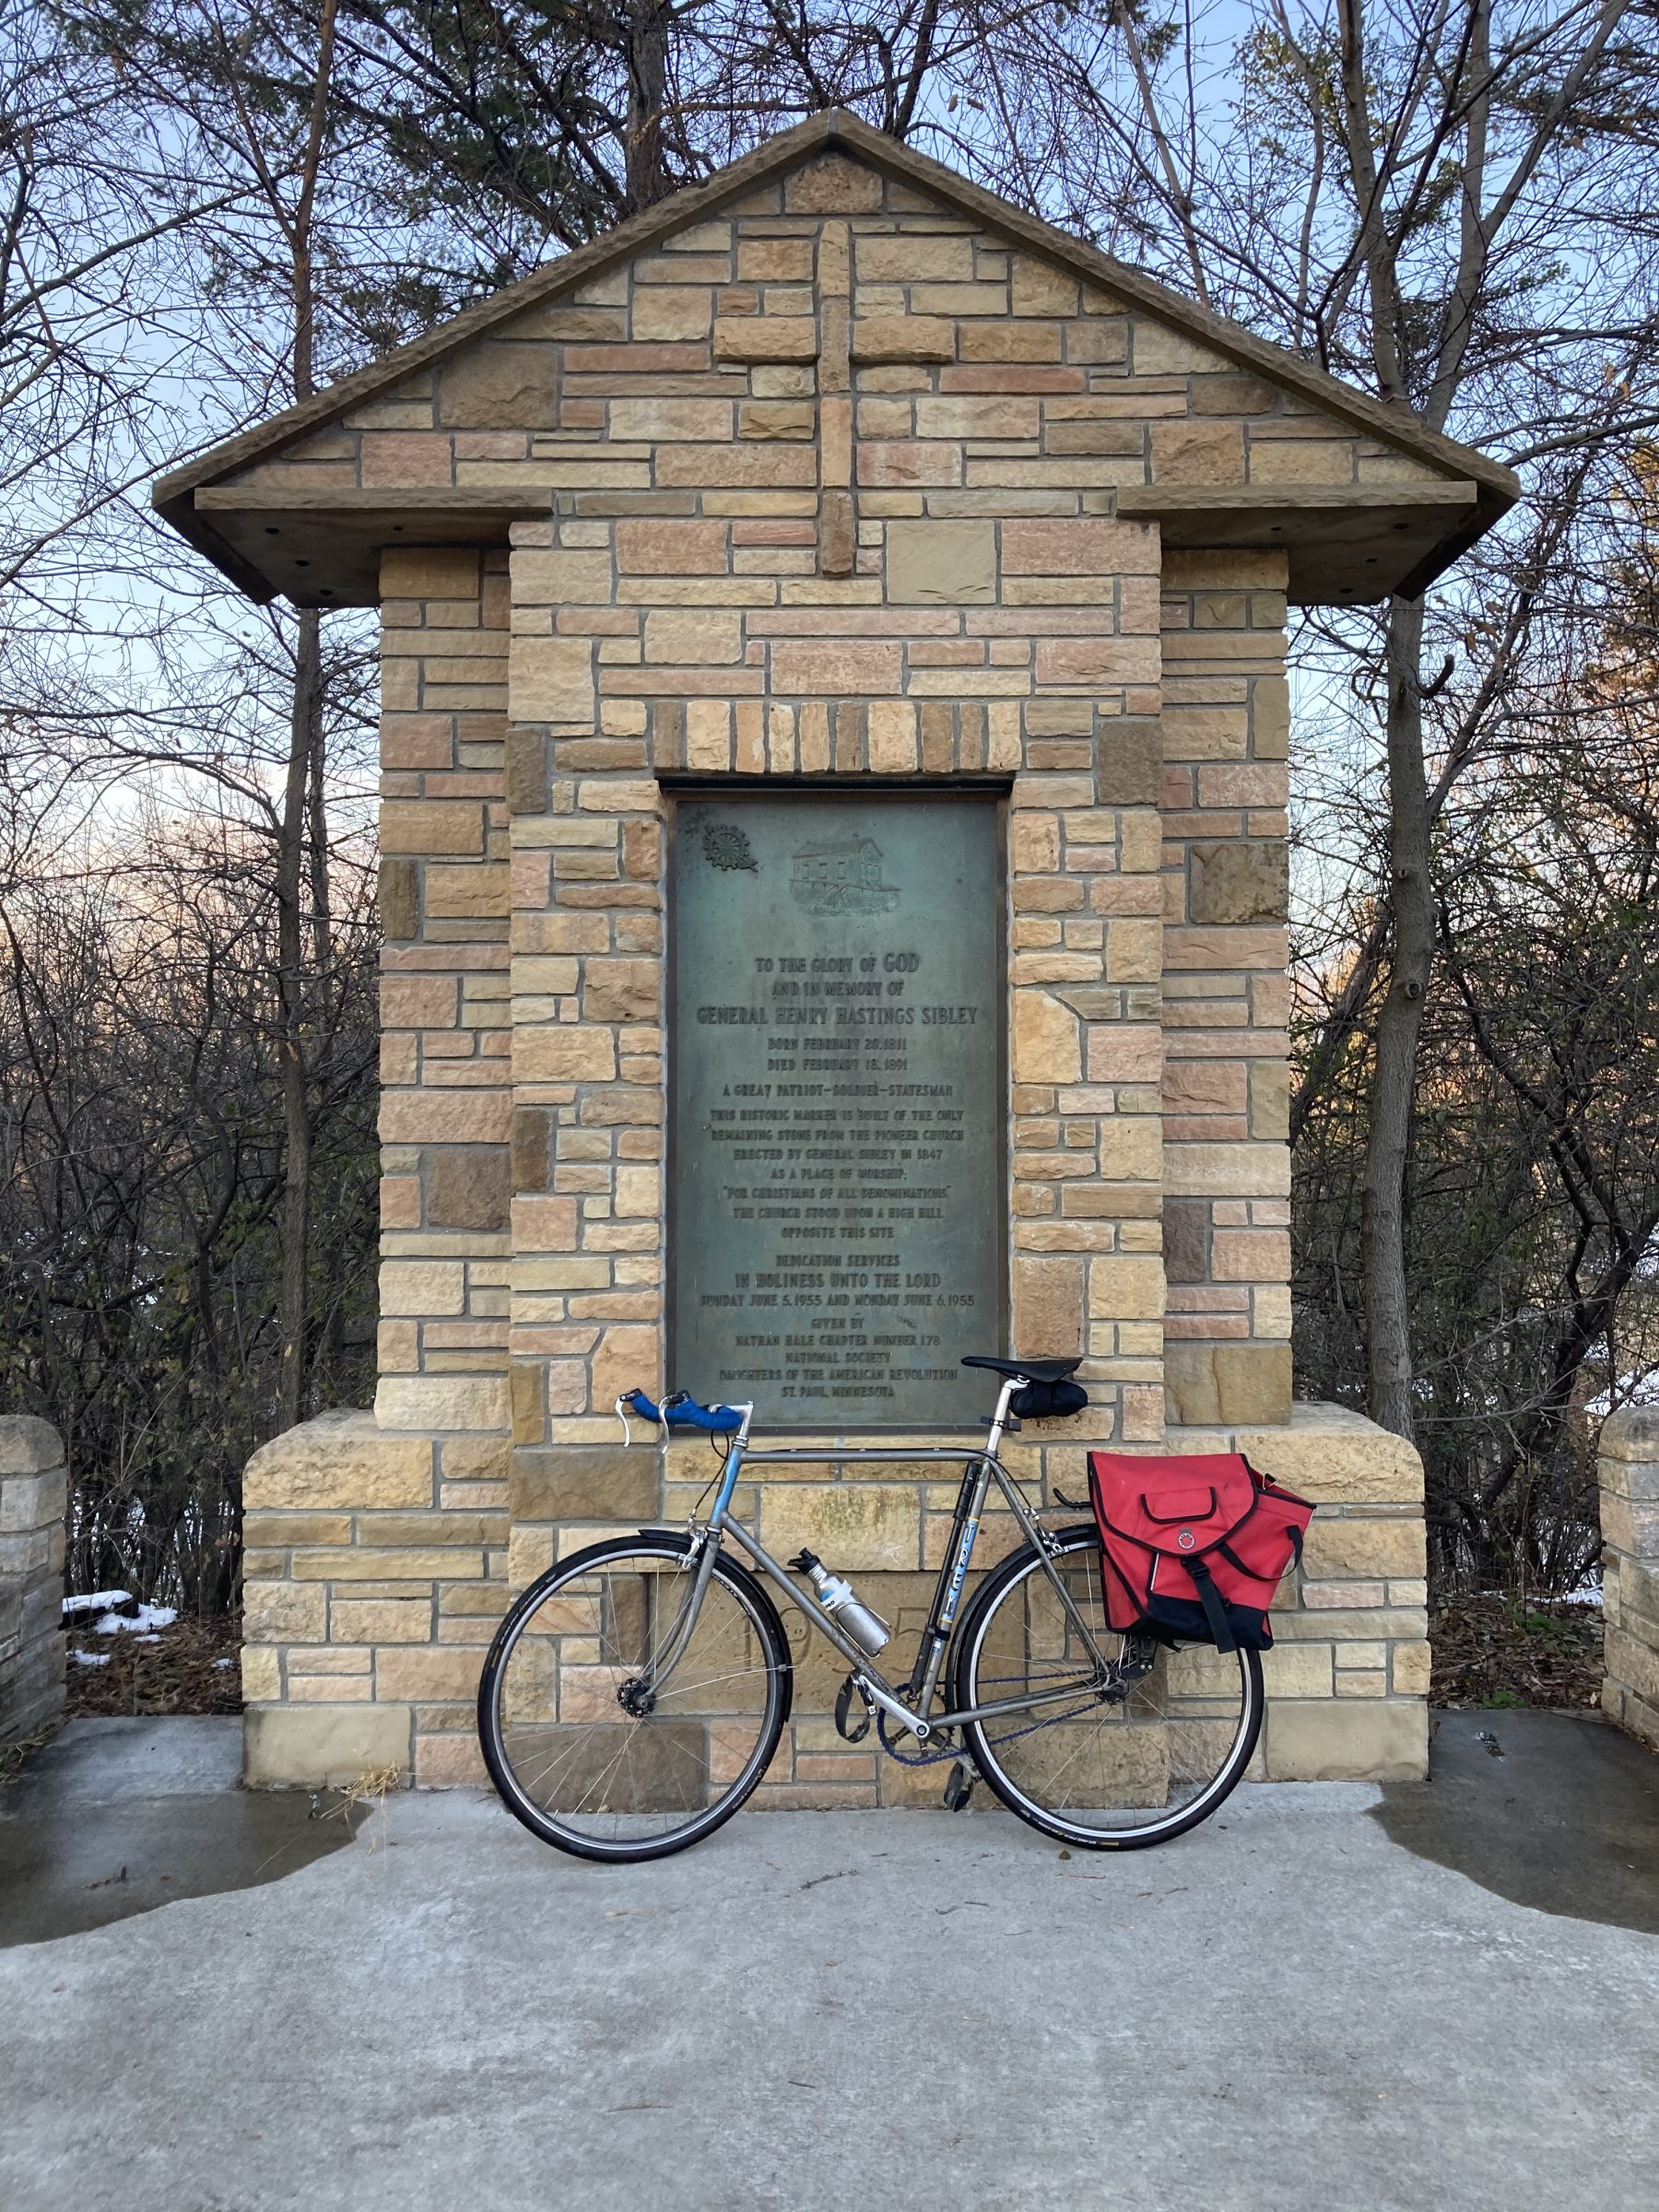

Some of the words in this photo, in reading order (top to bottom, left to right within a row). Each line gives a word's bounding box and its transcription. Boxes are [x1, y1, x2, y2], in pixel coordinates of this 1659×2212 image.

[755, 957, 774, 973] TO
[779, 957, 806, 973] THE
[810, 957, 853, 973] GLORY
[859, 957, 877, 973] OF
[882, 952, 921, 973] GOD
[771, 981, 799, 996] AND
[803, 981, 820, 996] IN
[824, 981, 882, 996] MEMORY
[886, 981, 905, 996] OF
[696, 1006, 768, 1025] GENERAL
[775, 1006, 829, 1025] HENRY
[835, 1006, 914, 1025] HASTINGS
[920, 1006, 978, 1025] SIBLEY
[767, 1038, 798, 1051] BORN
[803, 1038, 860, 1051] FEBRUARY
[767, 1058, 796, 1071] DIED
[803, 1058, 859, 1071] FEBRUARY
[722, 1084, 732, 1097] A
[734, 1084, 771, 1097] GREAT
[710, 1110, 735, 1122] THIS
[739, 1110, 789, 1122] HISTORIC
[794, 1110, 837, 1122] MARKER
[841, 1110, 853, 1122] IS
[857, 1110, 890, 1122] BUILT
[892, 1110, 907, 1122] OF
[911, 1110, 933, 1122] THE
[935, 1110, 965, 1122] ONLY
[710, 1129, 773, 1141] REMAINING
[776, 1129, 812, 1141] STONE
[815, 1129, 845, 1141] FROM
[849, 1129, 871, 1141] THE
[874, 1129, 920, 1141] PIONEER
[923, 1129, 964, 1141] CHURCH
[733, 1148, 783, 1160] ERECTED
[786, 1148, 801, 1160] BY
[805, 1148, 853, 1160] GENERAL
[858, 1148, 897, 1160] SIBLEY
[900, 1148, 912, 1160] IN
[915, 1148, 943, 1160] 1847
[770, 1168, 786, 1180] AS
[789, 1168, 797, 1180] A
[800, 1168, 835, 1180] PLACE
[839, 1168, 853, 1180] OF
[751, 1187, 817, 1199] CHRISTIANS
[819, 1187, 833, 1199] OF
[837, 1187, 857, 1199] ALL
[732, 1207, 754, 1218] THE
[757, 1207, 801, 1218] CHURCH
[804, 1207, 841, 1218] STOOD
[844, 1207, 874, 1218] UPON
[876, 1207, 884, 1218] A
[888, 1207, 914, 1218] HIGH
[918, 1207, 943, 1218] HILL
[781, 1227, 836, 1239] OPPOSITE
[840, 1227, 865, 1239] THIS
[868, 1227, 895, 1239] SITE
[774, 1253, 842, 1267] DEDICATION
[846, 1253, 900, 1267] SERVICES
[735, 1273, 749, 1288] IN
[755, 1273, 825, 1288] HOLINESS
[830, 1273, 868, 1288] UNTO
[874, 1273, 900, 1288] THE
[906, 1273, 942, 1288] LORD
[700, 1294, 744, 1307] SUNDAY
[748, 1294, 778, 1307] JUNE
[826, 1294, 850, 1307] AND
[854, 1294, 900, 1307] MONDAY
[902, 1294, 932, 1307] JUNE
[810, 1318, 846, 1329] GIVEN
[850, 1318, 865, 1329] BY
[735, 1335, 781, 1347] NATHAN
[784, 1335, 815, 1347] HALE
[818, 1335, 867, 1347] CHAPTER
[873, 1335, 916, 1347] NUMBER
[920, 1335, 940, 1347] 178
[784, 1352, 840, 1363] NATIONAL
[844, 1352, 891, 1363] SOCIETY
[719, 1369, 782, 1381] DAUGHTERS
[785, 1369, 799, 1381] OF
[803, 1369, 824, 1381] THE
[828, 1369, 885, 1381] AMERICAN
[888, 1369, 959, 1381] REVOLUTION
[831, 1385, 895, 1398] MINNESOTA
[946, 1524, 975, 1616] TREK
